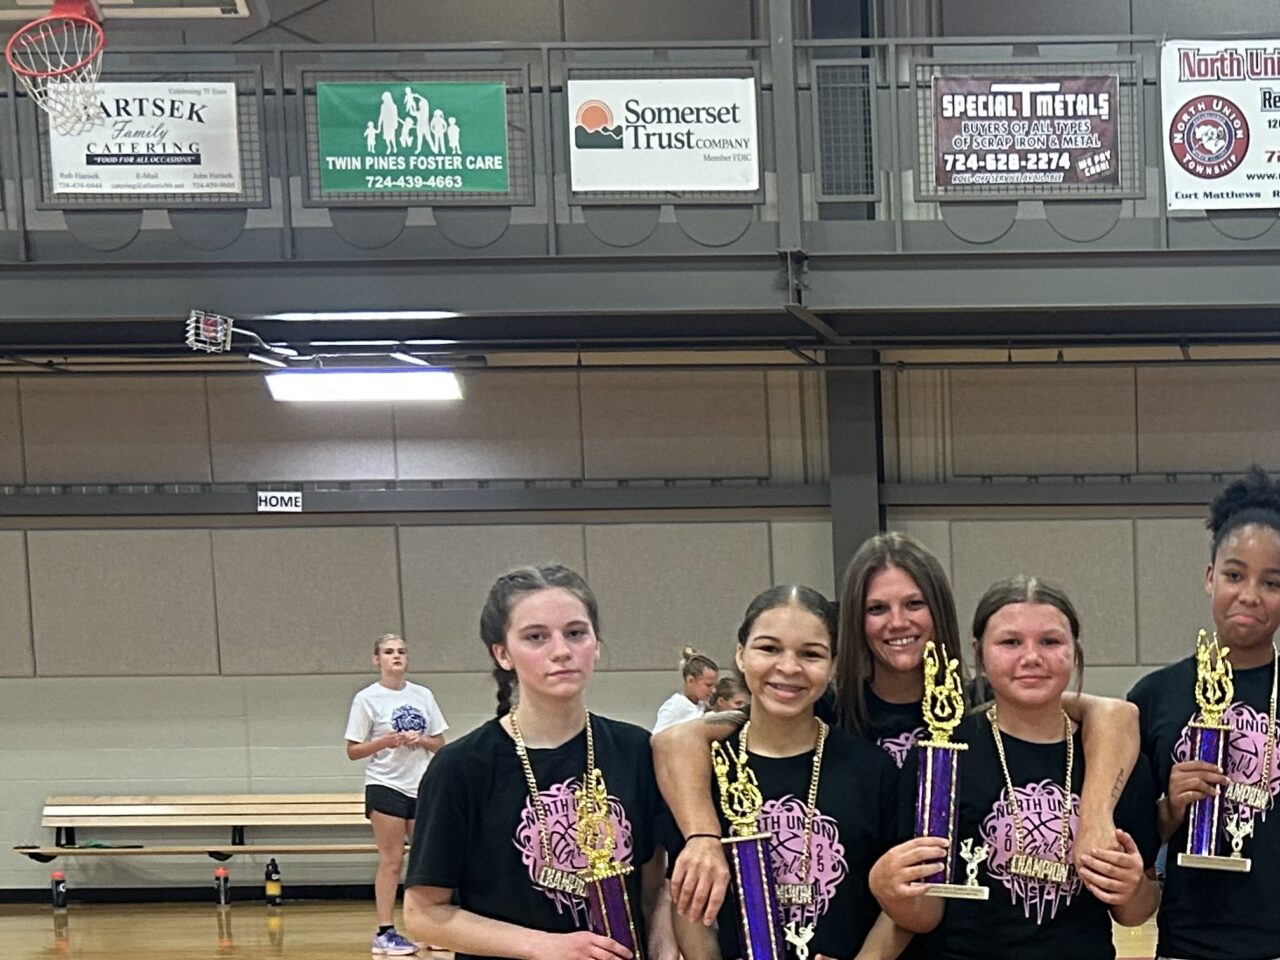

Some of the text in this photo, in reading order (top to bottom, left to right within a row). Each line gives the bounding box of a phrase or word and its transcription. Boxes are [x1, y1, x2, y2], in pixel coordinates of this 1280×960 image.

[1178, 47, 1245, 82] North
[96, 97, 208, 124] ARTSEK
[625, 99, 741, 124] Somerset
[942, 94, 1017, 117] SPECIAL
[1036, 93, 1110, 117] METALS
[962, 119, 1091, 135] BUYERS OF ALL TYPES
[1173, 99, 1244, 144] NORTH UNION
[111, 120, 168, 144] Family
[626, 125, 750, 150] Trust COMPANY
[952, 133, 1100, 150] OF SCRAP IRON & METAL
[86, 142, 200, 154] CATERING
[1093, 150, 1111, 165] PAY
[119, 156, 135, 164] FOR
[135, 156, 149, 164] ALL
[326, 155, 503, 170] TWIN PINES FOSTER CARE
[703, 154, 752, 162] Member FDIC
[944, 152, 1070, 171] 724-628-2274
[1183, 153, 1237, 175] TOWNSHIP
[365, 175, 462, 189] 724-439-4663
[1174, 191, 1199, 200] Curt
[1202, 191, 1261, 199] Matthews
[258, 495, 301, 507] HOME
[786, 815, 832, 842] UNON
[1010, 853, 1069, 883] CHAMPION
